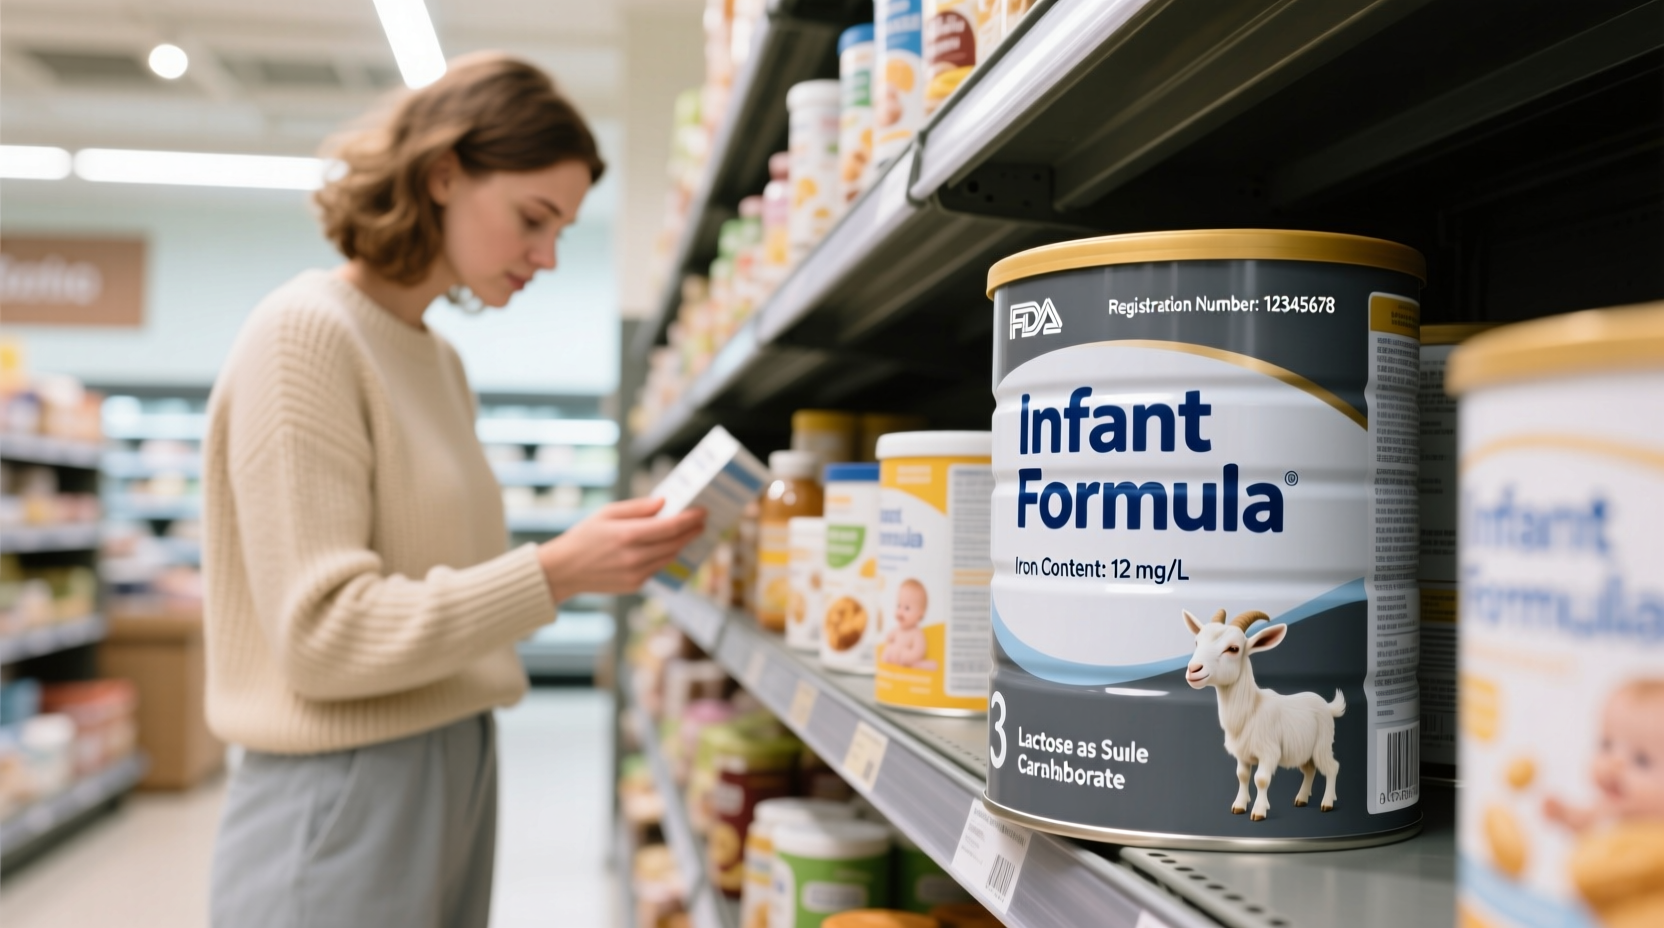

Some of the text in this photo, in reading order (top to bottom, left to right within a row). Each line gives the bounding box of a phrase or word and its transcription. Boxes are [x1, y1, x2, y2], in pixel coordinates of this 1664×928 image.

[1009, 297, 1064, 341] FDA
[1109, 295, 1336, 319] Registration Number: 12345678
[1019, 386, 1212, 455] Infant
[1015, 556, 1190, 585] Iron Content: 12 mg/L
[990, 690, 1008, 769] 3
[1018, 725, 1074, 755] Lactose
[1076, 741, 1097, 759] as
